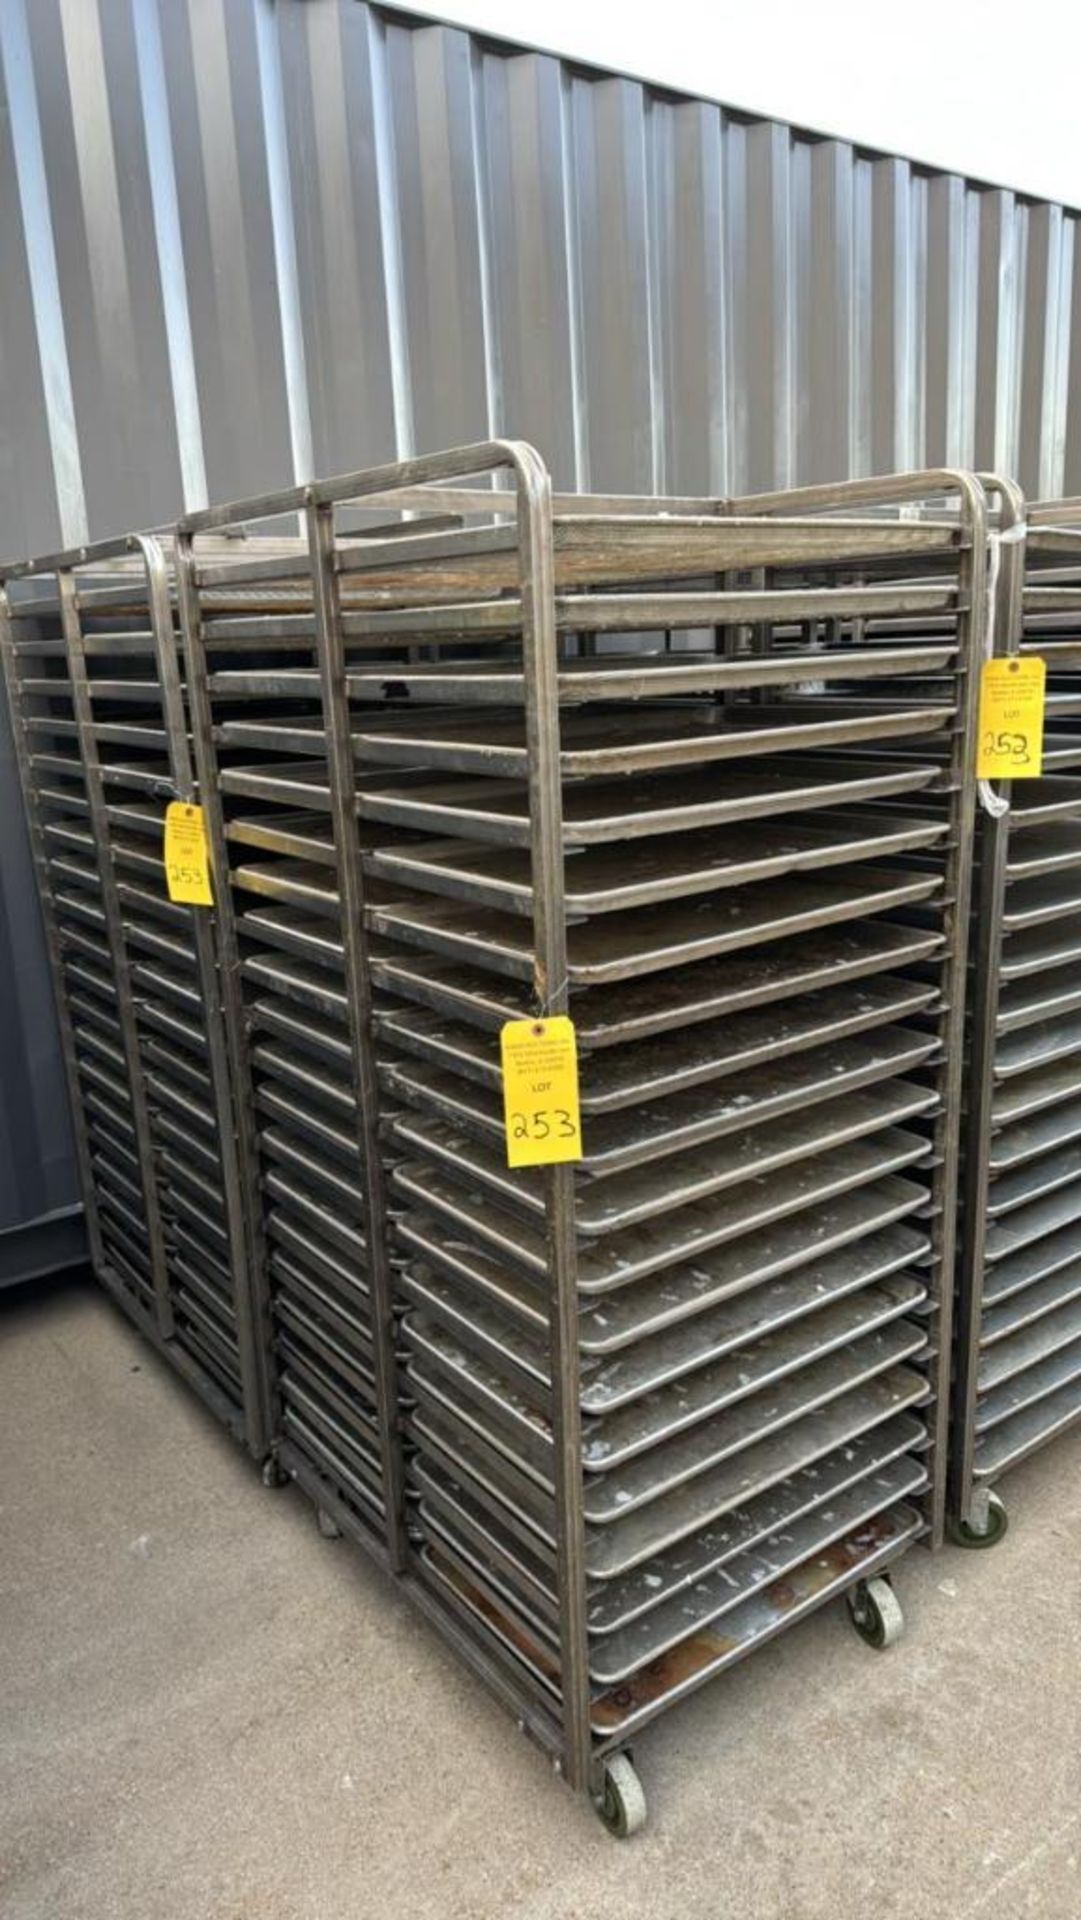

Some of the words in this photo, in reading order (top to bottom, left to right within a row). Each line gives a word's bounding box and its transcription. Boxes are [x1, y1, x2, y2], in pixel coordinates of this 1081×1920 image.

[168, 863, 204, 885] 253
[531, 1082, 552, 1093] LOT
[511, 1109, 576, 1139] 253
